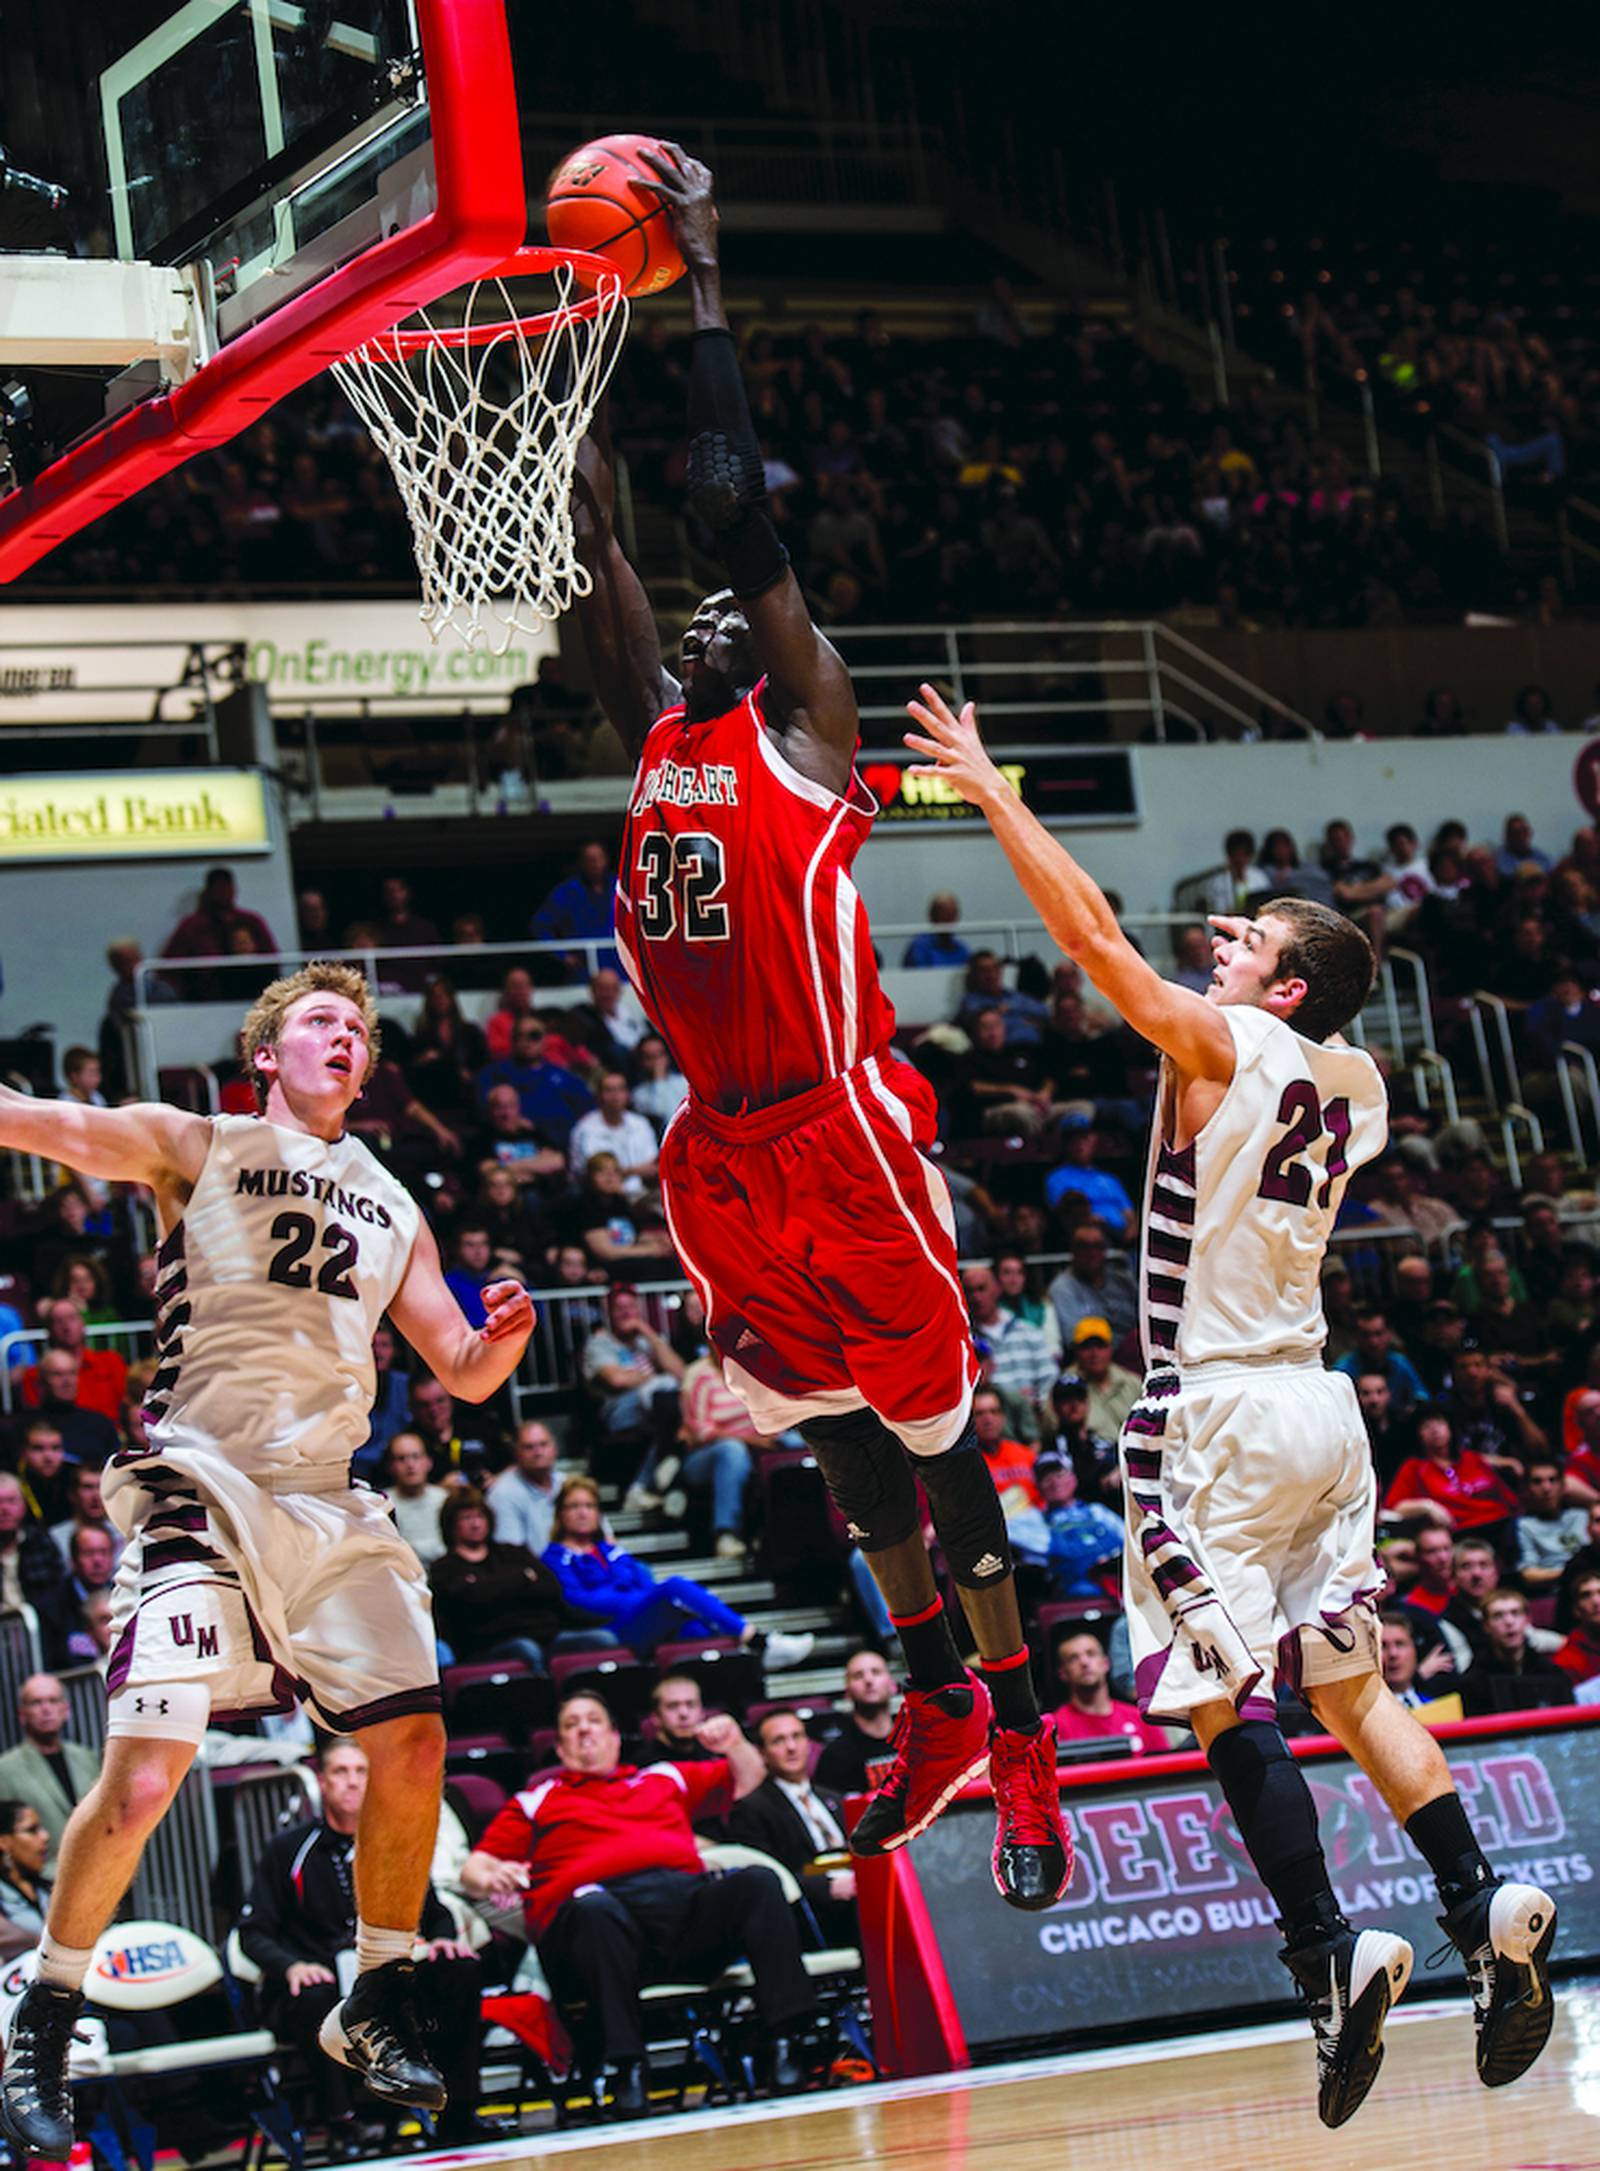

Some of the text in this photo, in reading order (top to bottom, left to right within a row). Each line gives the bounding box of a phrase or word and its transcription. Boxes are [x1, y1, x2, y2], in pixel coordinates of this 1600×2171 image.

[124, 790, 230, 833] Bank
[637, 831, 730, 941] 32
[1257, 1079, 1351, 1209] 21
[234, 1168, 392, 1229] MUSTANGS
[268, 1211, 359, 1301] 22
[168, 1613, 220, 1659] UM
[1039, 1905, 1202, 1954] CHICAGO
[1205, 1895, 1282, 1932] BULL
[1332, 1872, 1438, 1915] LAYOF
